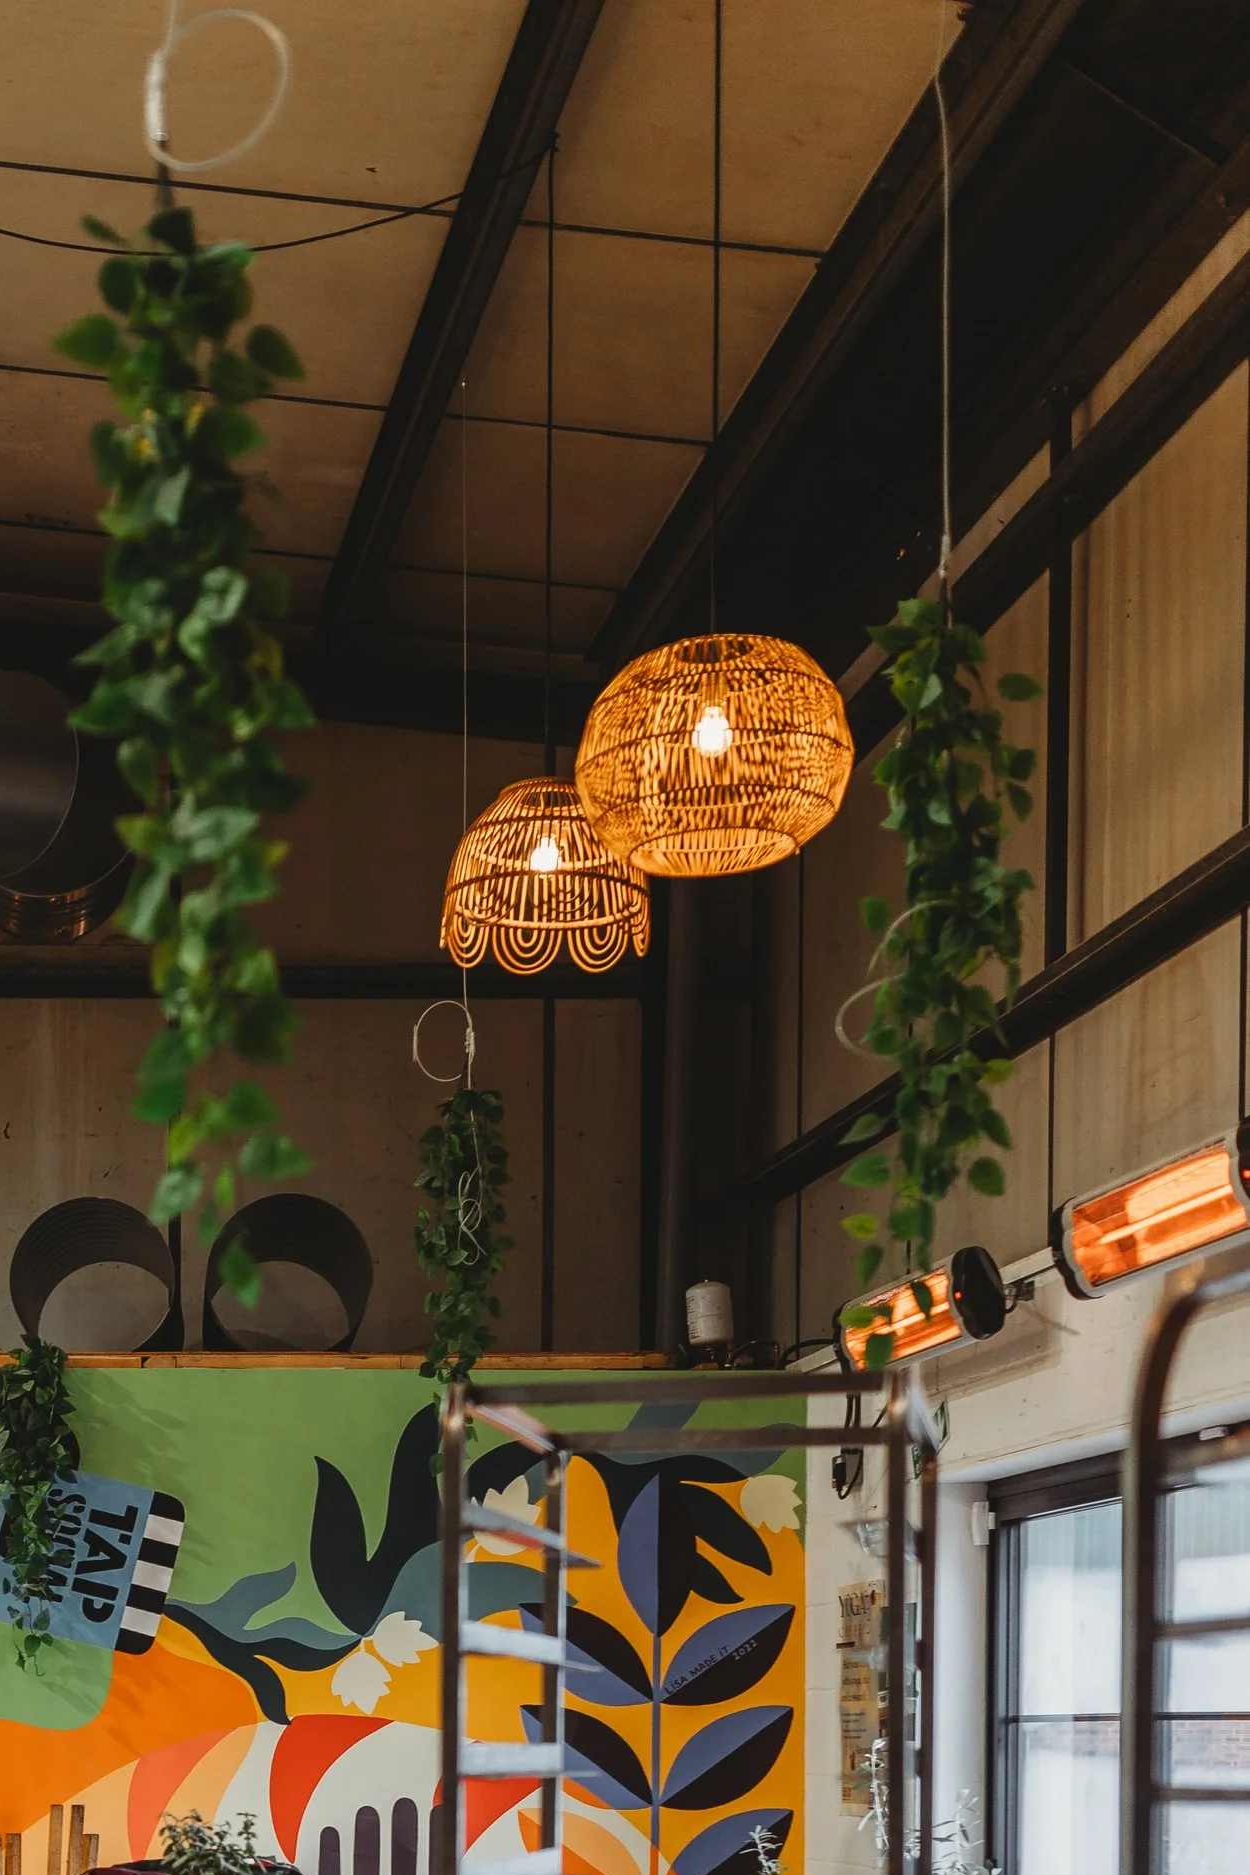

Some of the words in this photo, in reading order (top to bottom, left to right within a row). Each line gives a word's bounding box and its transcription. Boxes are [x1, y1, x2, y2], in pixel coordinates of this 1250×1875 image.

[70, 1504, 139, 1623] TAP
[731, 1639, 759, 1661] 2022
[689, 1654, 718, 1678] MADE
